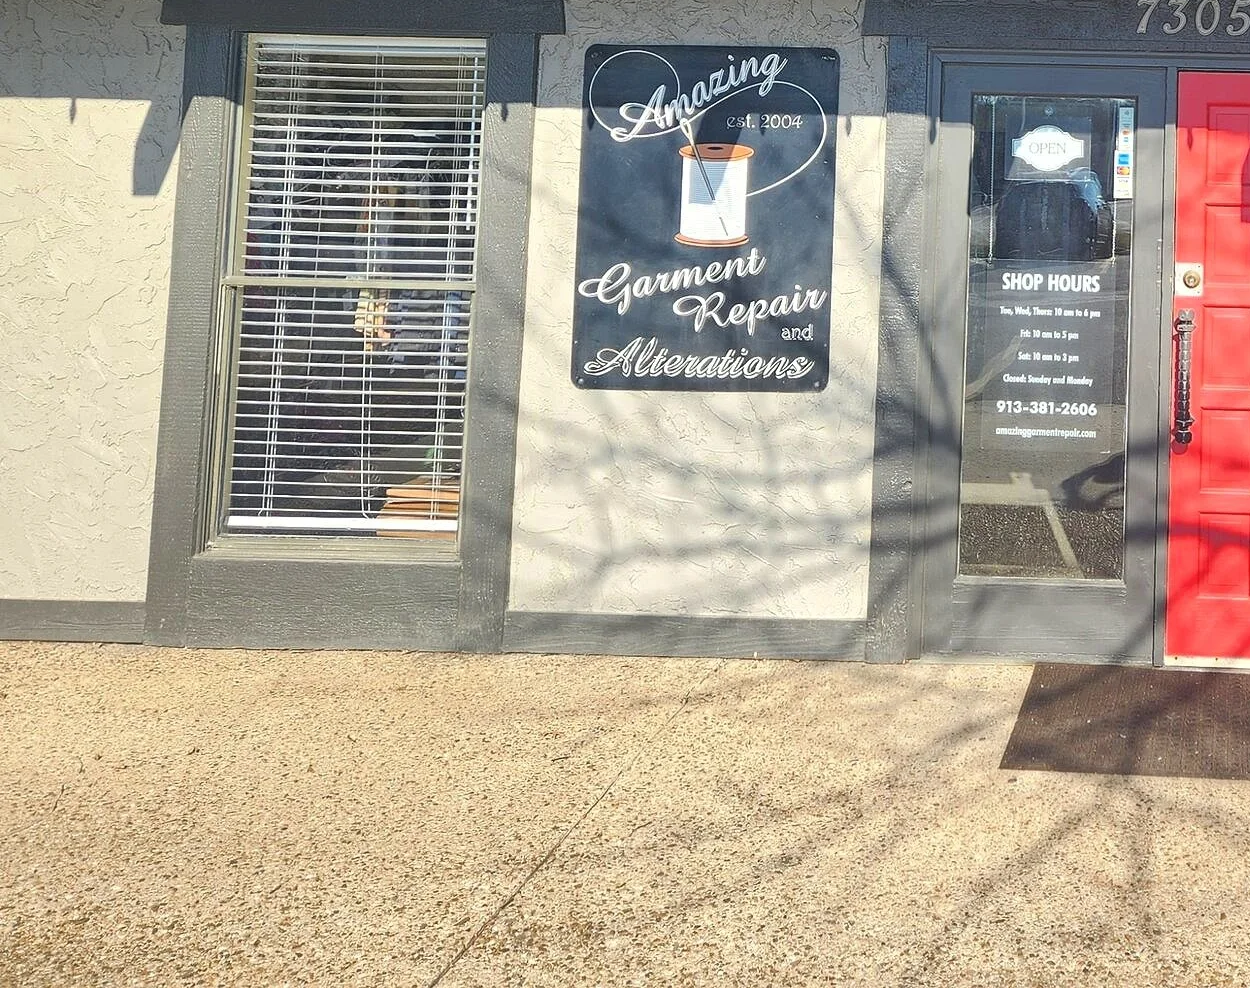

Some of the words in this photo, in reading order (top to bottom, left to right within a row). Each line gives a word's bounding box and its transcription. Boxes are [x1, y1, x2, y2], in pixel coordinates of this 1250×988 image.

[610, 52, 788, 142] Amazing
[726, 115, 755, 129] est.
[760, 114, 803, 130] 2004
[1028, 141, 1066, 155] OPEN
[578, 247, 767, 315] Garment
[1002, 272, 1043, 291] SHOP
[1047, 274, 1101, 293] HOURS
[672, 284, 828, 336] Repair
[1014, 306, 1032, 316] Wed,
[1054, 307, 1062, 316] 10
[1063, 309, 1074, 317] am
[1075, 309, 1083, 317] to
[1083, 309, 1089, 317] 6
[1089, 310, 1101, 319] pm
[781, 323, 814, 341] and
[1020, 329, 1031, 338] Fri:
[1032, 329, 1041, 338] 10
[1041, 331, 1053, 339] am
[1053, 330, 1061, 339] to
[1061, 331, 1067, 339] 5
[1067, 332, 1079, 341] pm
[583, 336, 815, 380] Alterations
[1017, 351, 1031, 361] Sat:
[1032, 351, 1041, 361] 10
[1053, 353, 1061, 362] to
[1062, 353, 1067, 362] 3
[1067, 355, 1079, 363] pm
[1002, 373, 1027, 383] Closed:
[1027, 374, 1052, 385] Sunday
[1052, 375, 1066, 384] and
[1066, 376, 1093, 387] Monday
[996, 400, 1098, 416] 913-381-2606
[995, 426, 1097, 439] amazinggarmentrepair.com
